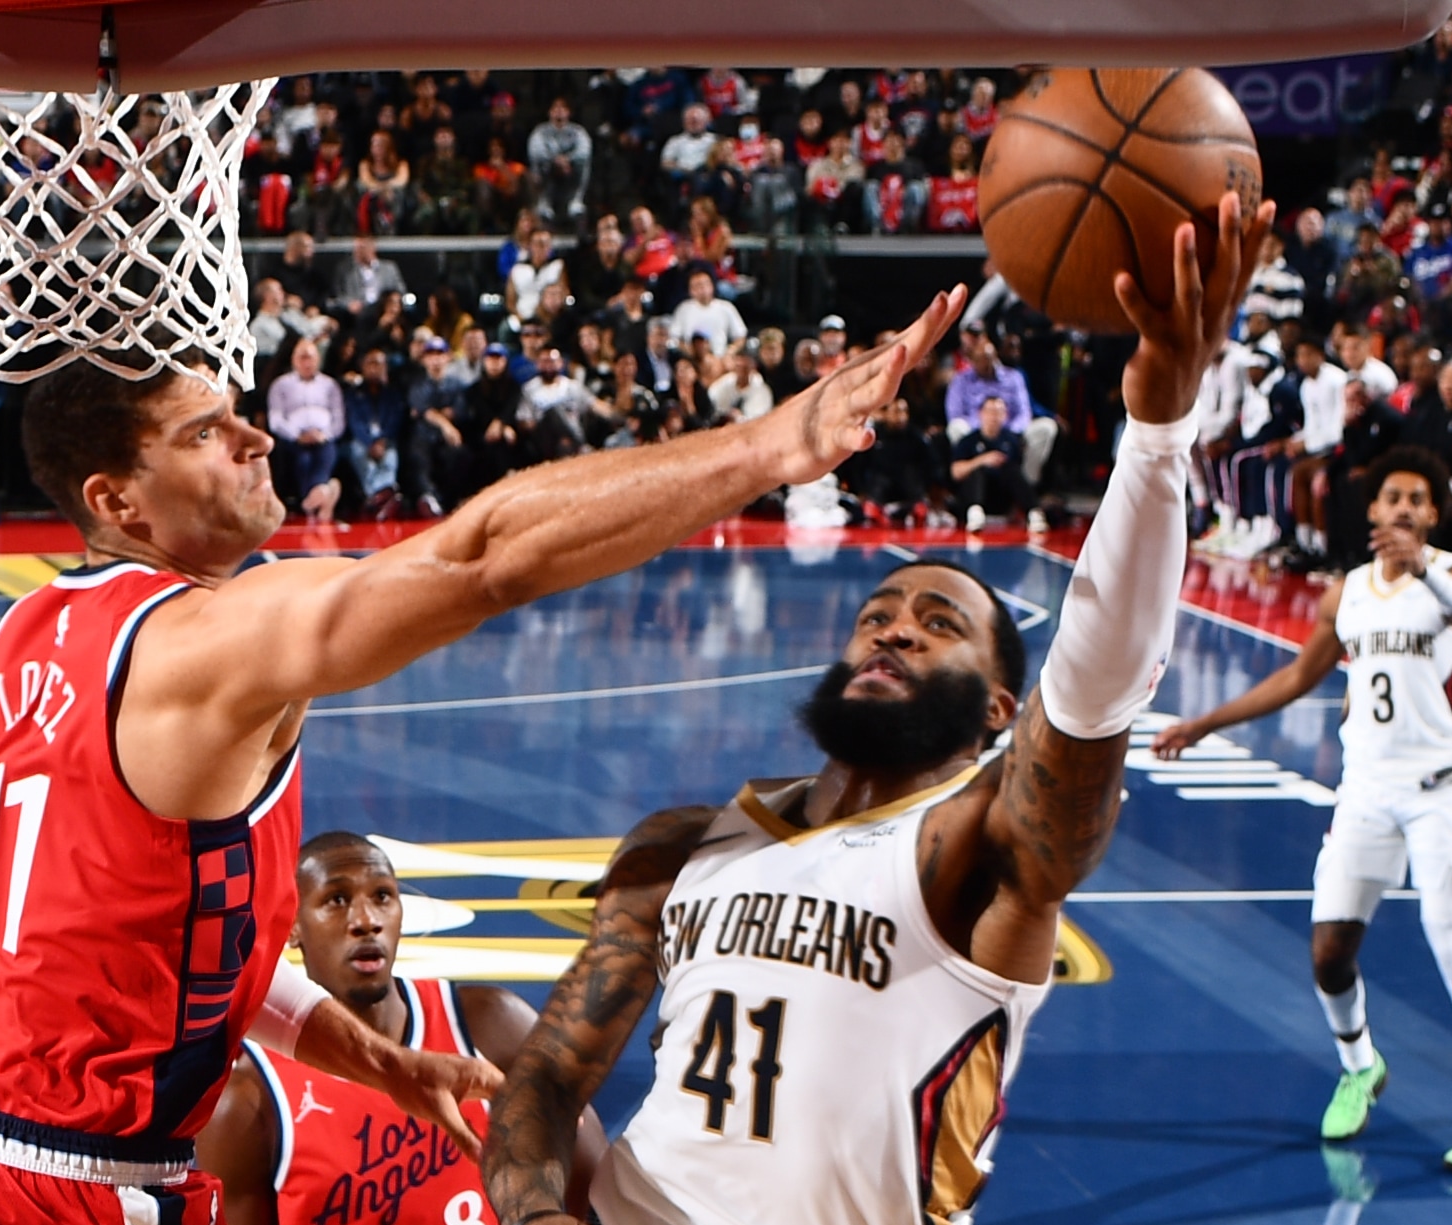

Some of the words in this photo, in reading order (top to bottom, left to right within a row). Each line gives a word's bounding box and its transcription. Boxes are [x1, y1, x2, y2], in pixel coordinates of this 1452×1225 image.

[1371, 671, 1395, 724] 3
[656, 895, 719, 984] EW
[714, 891, 898, 992] ORLEANS
[680, 989, 788, 1144] 41
[353, 1114, 426, 1175] Los
